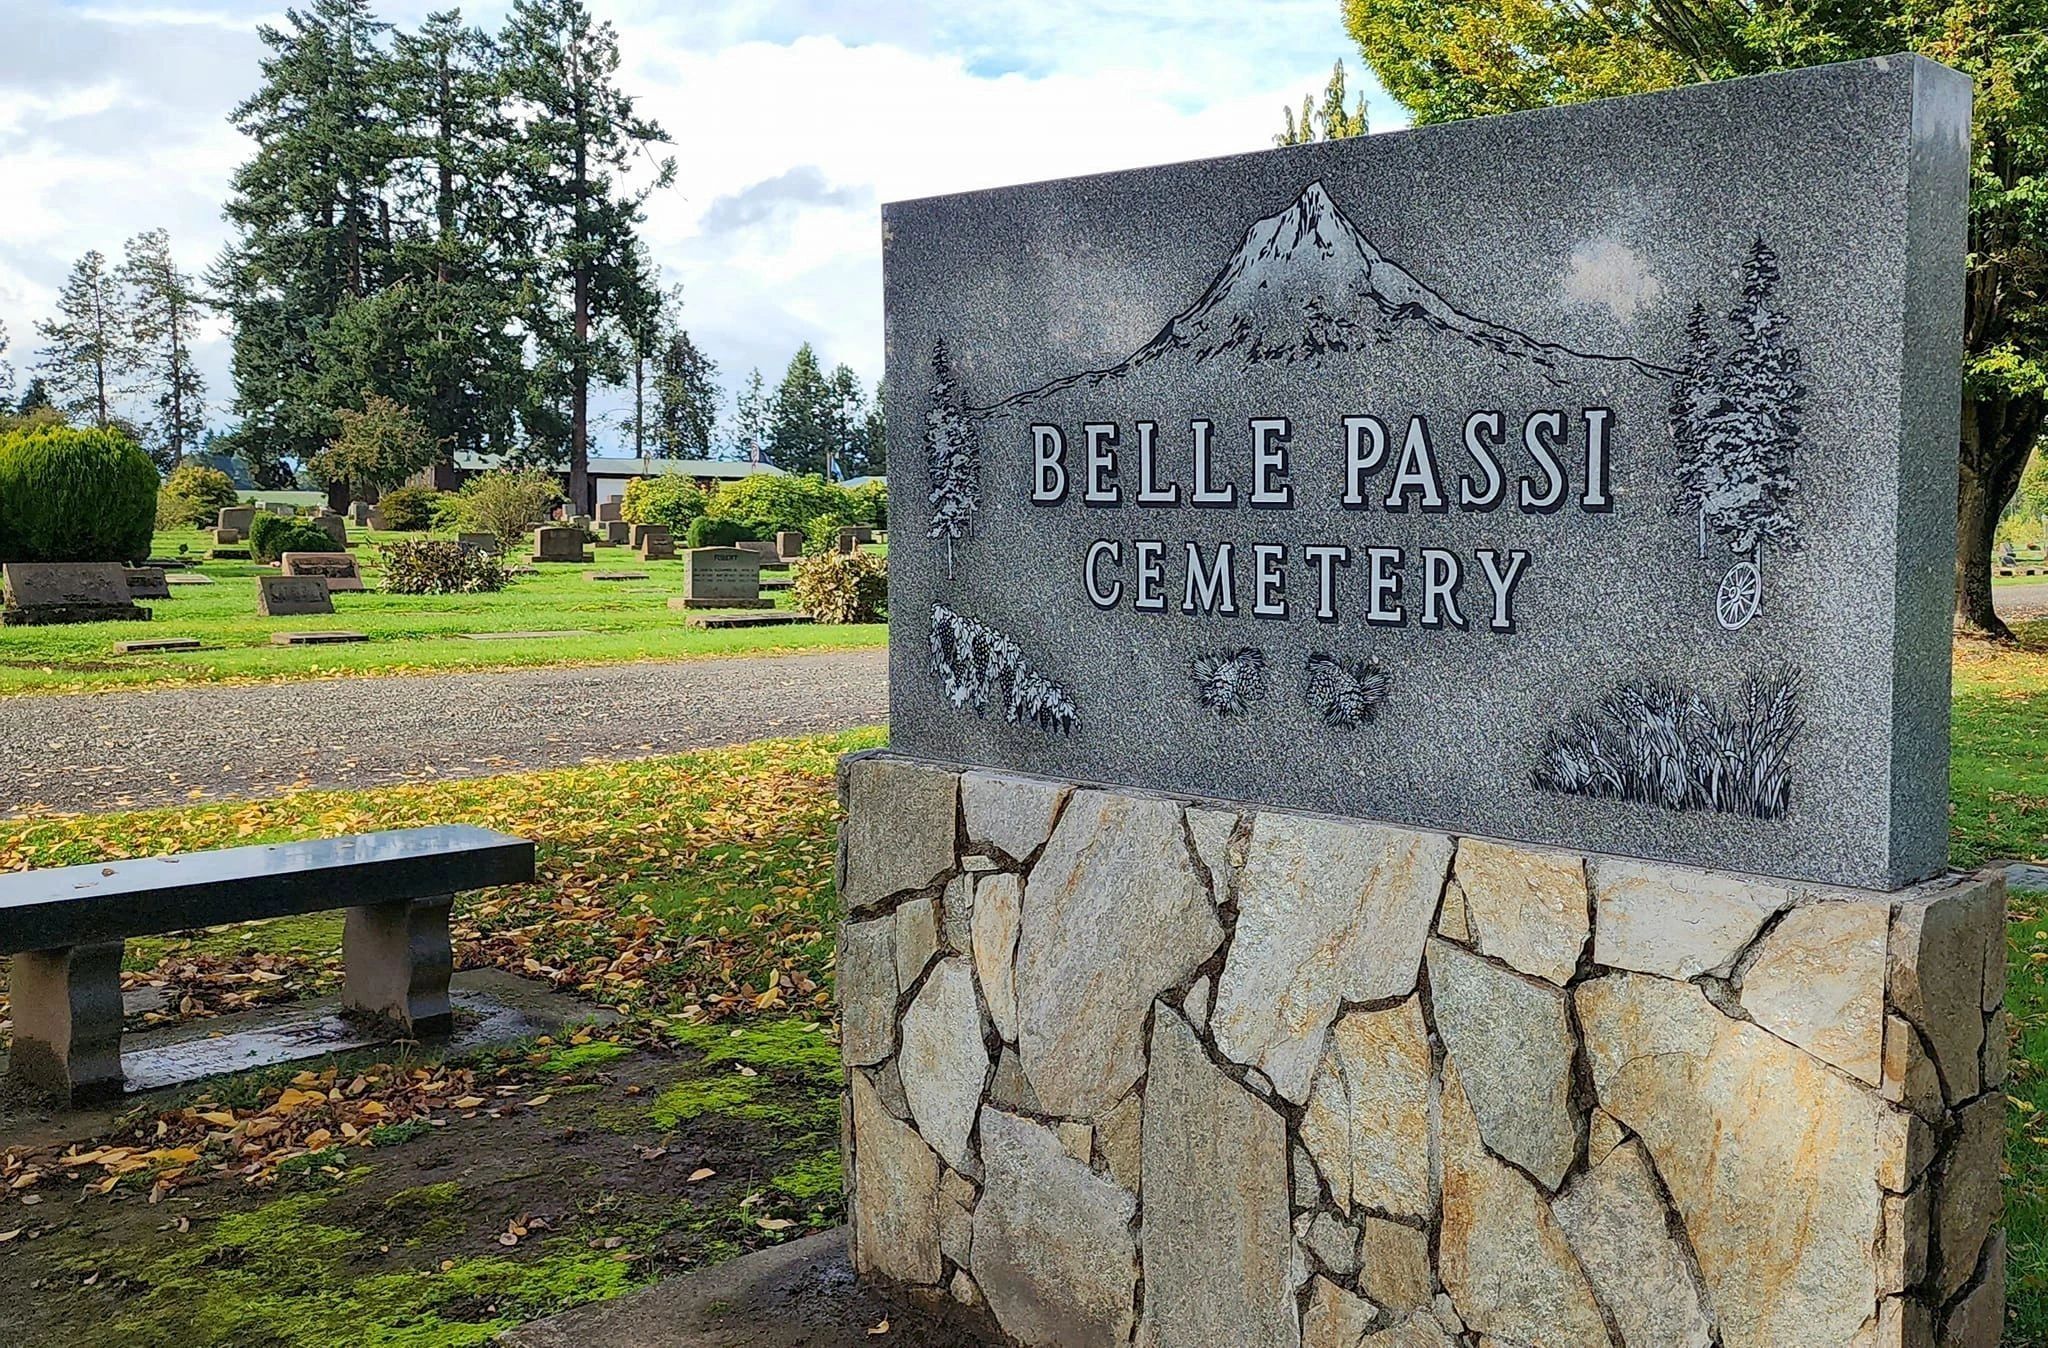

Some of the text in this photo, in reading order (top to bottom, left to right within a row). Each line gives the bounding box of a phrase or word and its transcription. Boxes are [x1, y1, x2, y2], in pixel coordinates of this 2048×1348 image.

[1030, 407, 1615, 513] BELLE PASSI
[1084, 540, 1530, 633] CEMETERY
